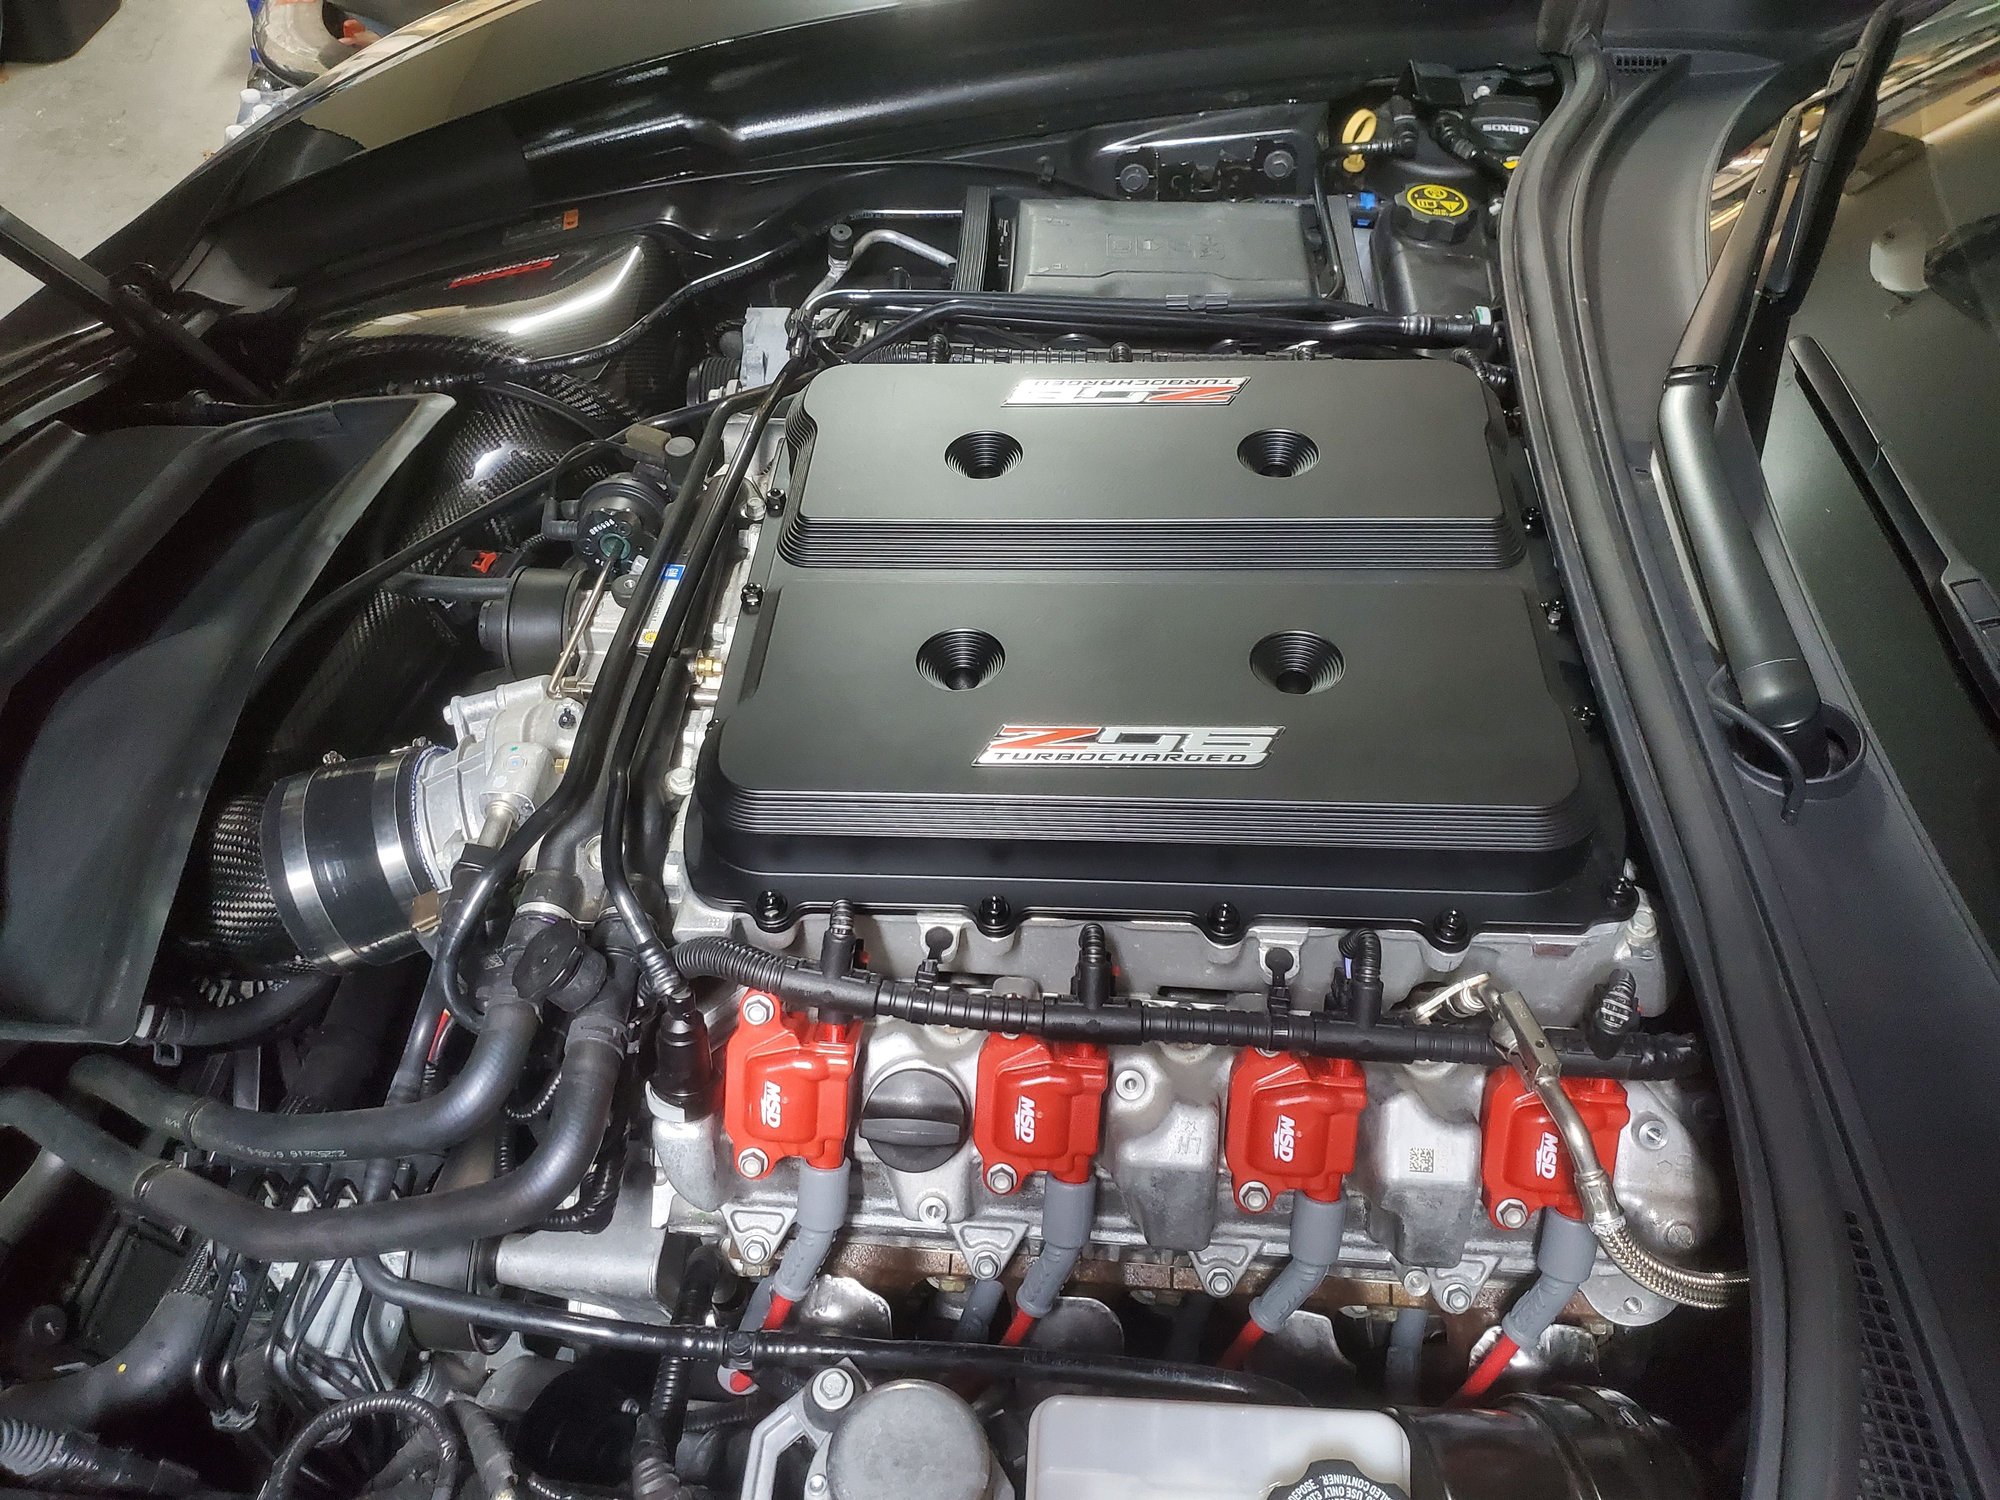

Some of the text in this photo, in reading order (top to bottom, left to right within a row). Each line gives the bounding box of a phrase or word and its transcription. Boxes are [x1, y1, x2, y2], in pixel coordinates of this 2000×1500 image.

[1482, 123, 1530, 135] dexos
[989, 726, 1278, 753] Z06
[994, 752, 1249, 763] TURBOCHARGED
[763, 1079, 782, 1129] MSD
[1016, 1095, 1035, 1143] MSD
[1276, 1114, 1295, 1162] MSD
[1538, 1131, 1559, 1179] MSD
[1319, 1473, 1370, 1492] CONTAINER.
[1304, 1490, 1322, 1500] OT3
[1323, 1486, 1345, 1498] ONLY
[1345, 1486, 1364, 1500] USE
[1369, 1485, 1393, 1500] LED
